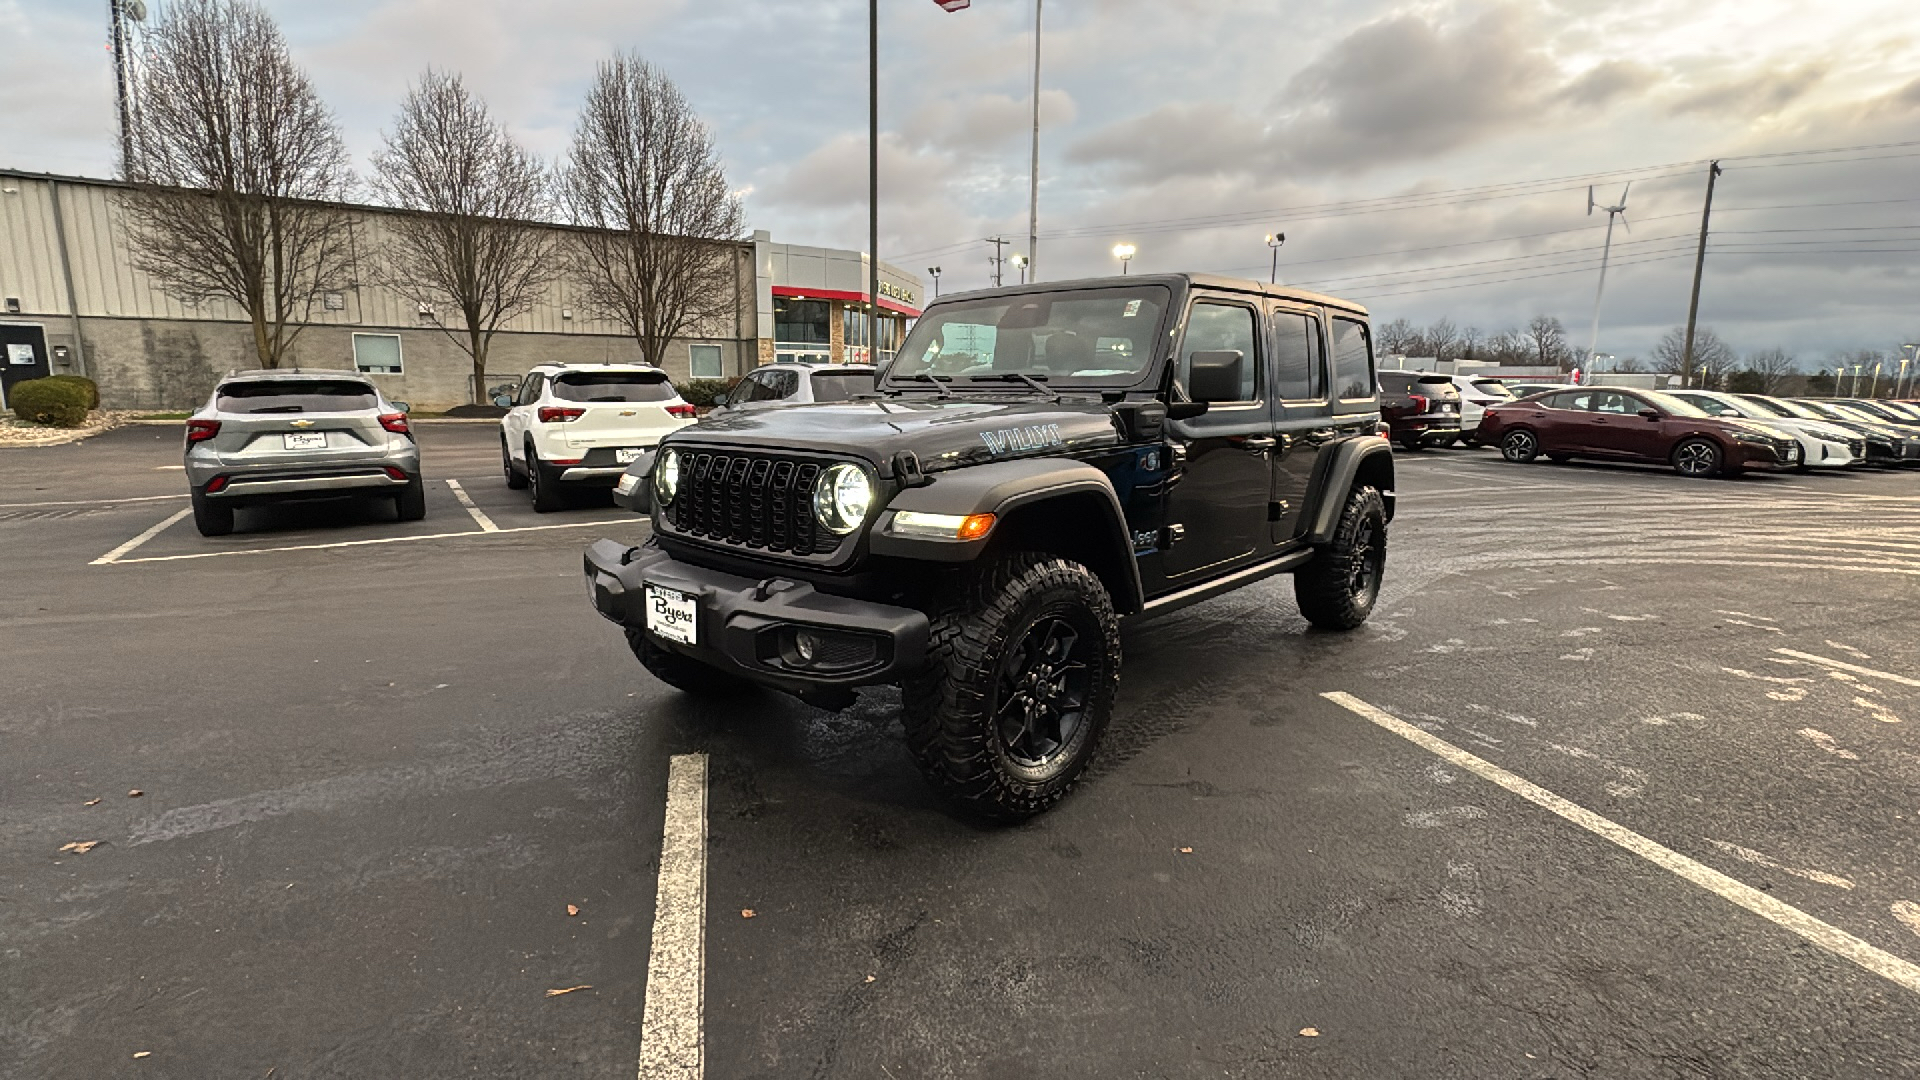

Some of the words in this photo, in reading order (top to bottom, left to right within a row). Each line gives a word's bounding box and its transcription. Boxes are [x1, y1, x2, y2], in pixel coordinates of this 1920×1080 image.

[979, 423, 1062, 455] WILLYS
[1131, 529, 1158, 548] Jeep
[650, 595, 693, 625] Byers
